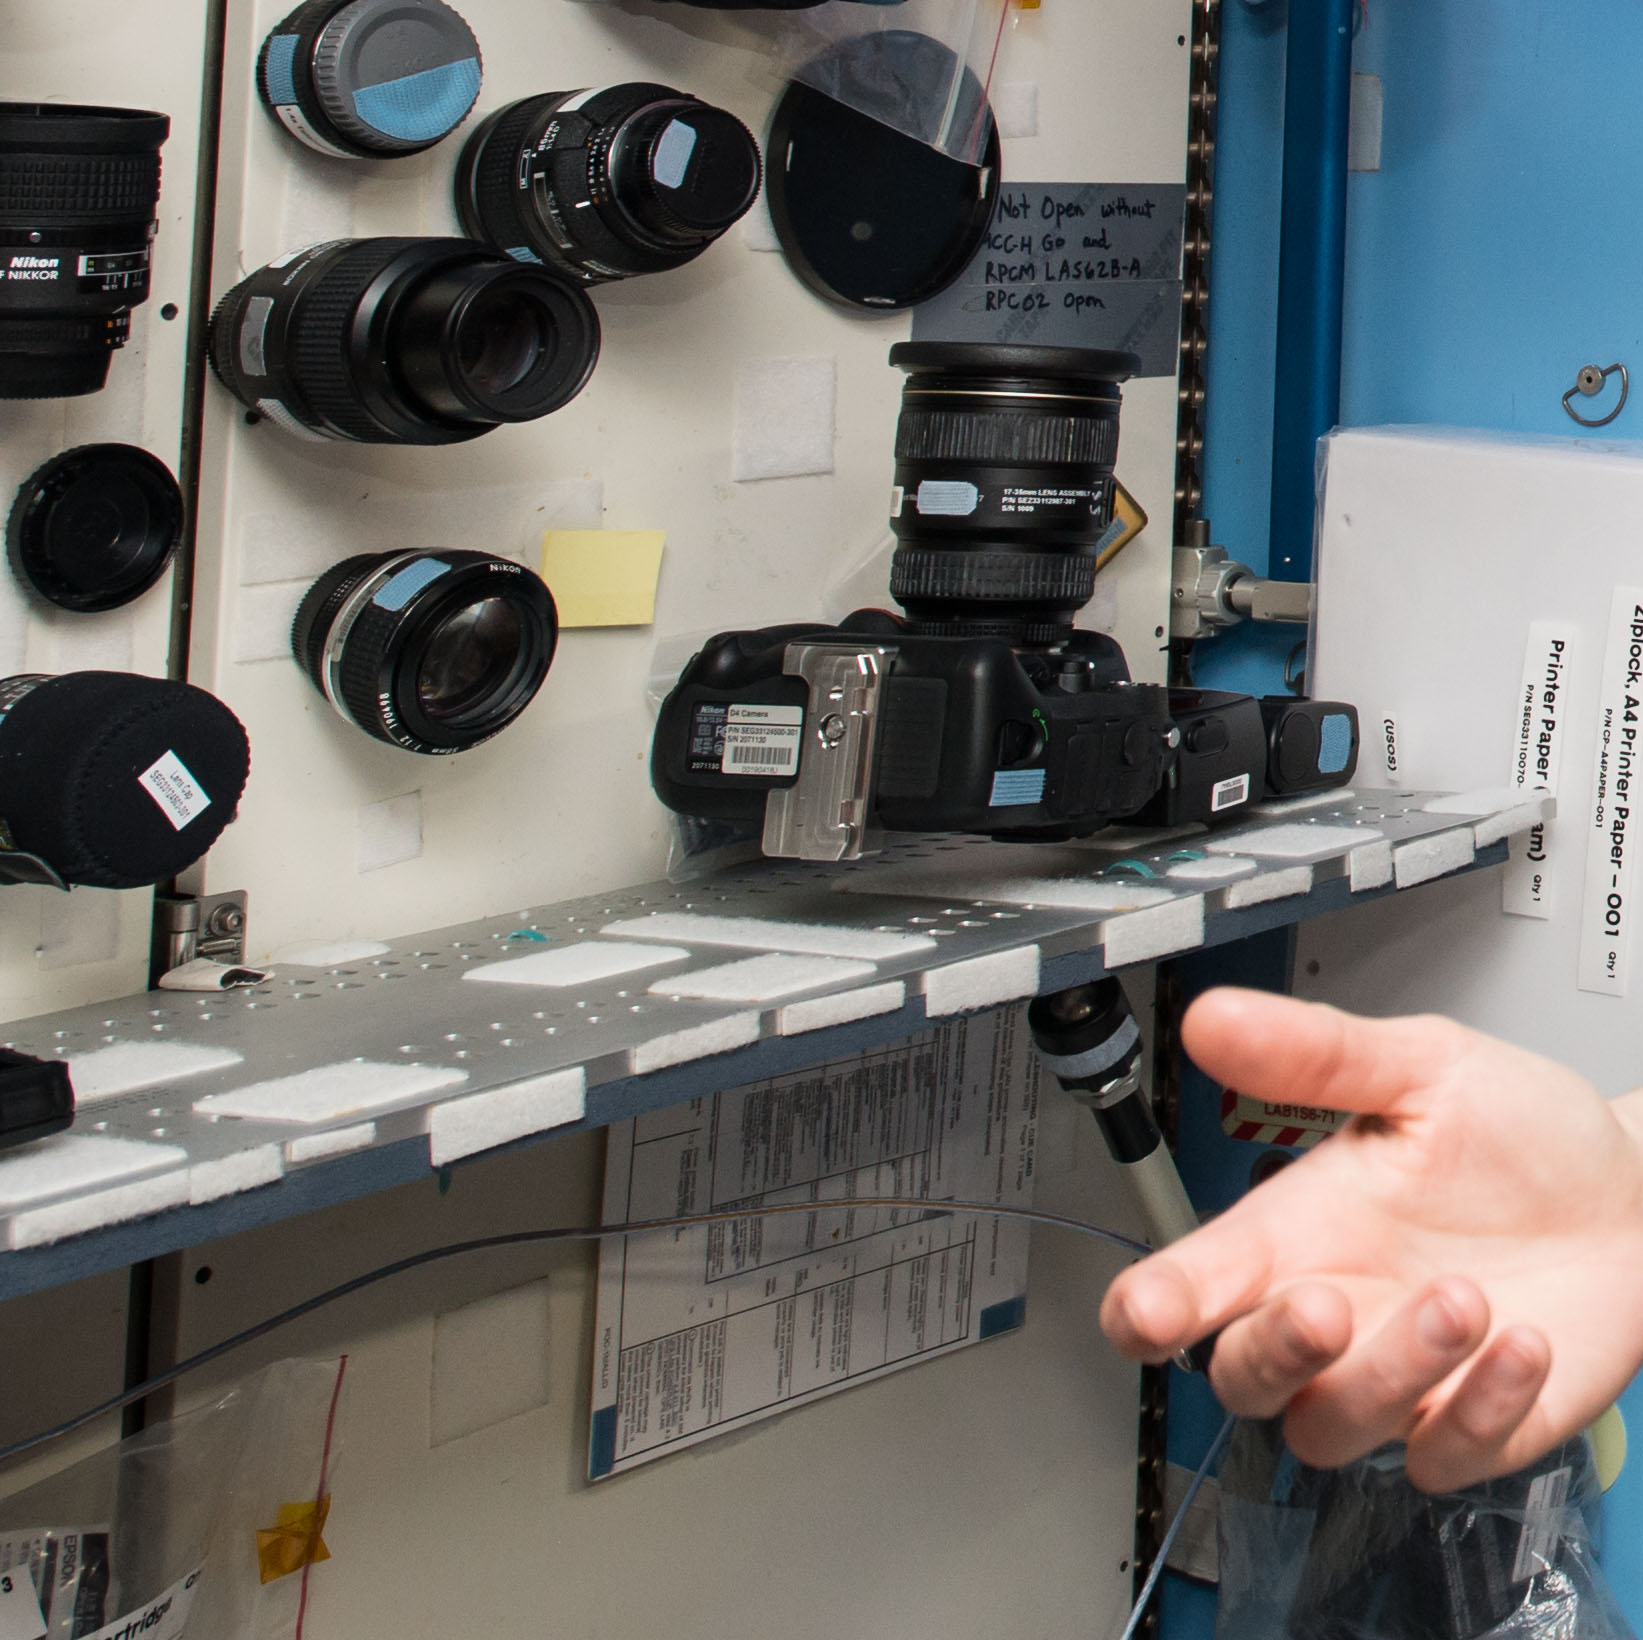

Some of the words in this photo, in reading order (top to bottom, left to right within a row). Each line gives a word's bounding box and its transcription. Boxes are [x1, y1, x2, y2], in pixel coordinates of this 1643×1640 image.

[1041, 195, 1085, 229] Open
[1100, 197, 1156, 220] without
[1042, 233, 1066, 252] Go
[1083, 228, 1112, 249] and
[10, 256, 60, 269] Nikon
[985, 261, 1035, 284] RPCM
[8, 270, 59, 281] NIKKOR
[1064, 292, 1105, 315] Open
[1038, 489, 1057, 497] LENS
[1059, 489, 1091, 497] ASSEMBLY
[490, 563, 521, 575] Nikon
[1542, 639, 1565, 714] Printer
[1524, 683, 1534, 705] P/N
[701, 705, 726, 714] Nikon
[741, 709, 768, 718] Camera
[1603, 708, 1613, 725] P/N
[1622, 695, 1640, 723] A4
[1383, 718, 1397, 772] (USOS)
[1535, 718, 1556, 781] Paper
[1615, 727, 1637, 800] Printer
[1609, 805, 1630, 870] Paper
[1532, 874, 1542, 895] Qty
[1603, 892, 1623, 937] 001
[1607, 950, 1616, 971] Qty
[1, 1576, 13, 1592] 3
